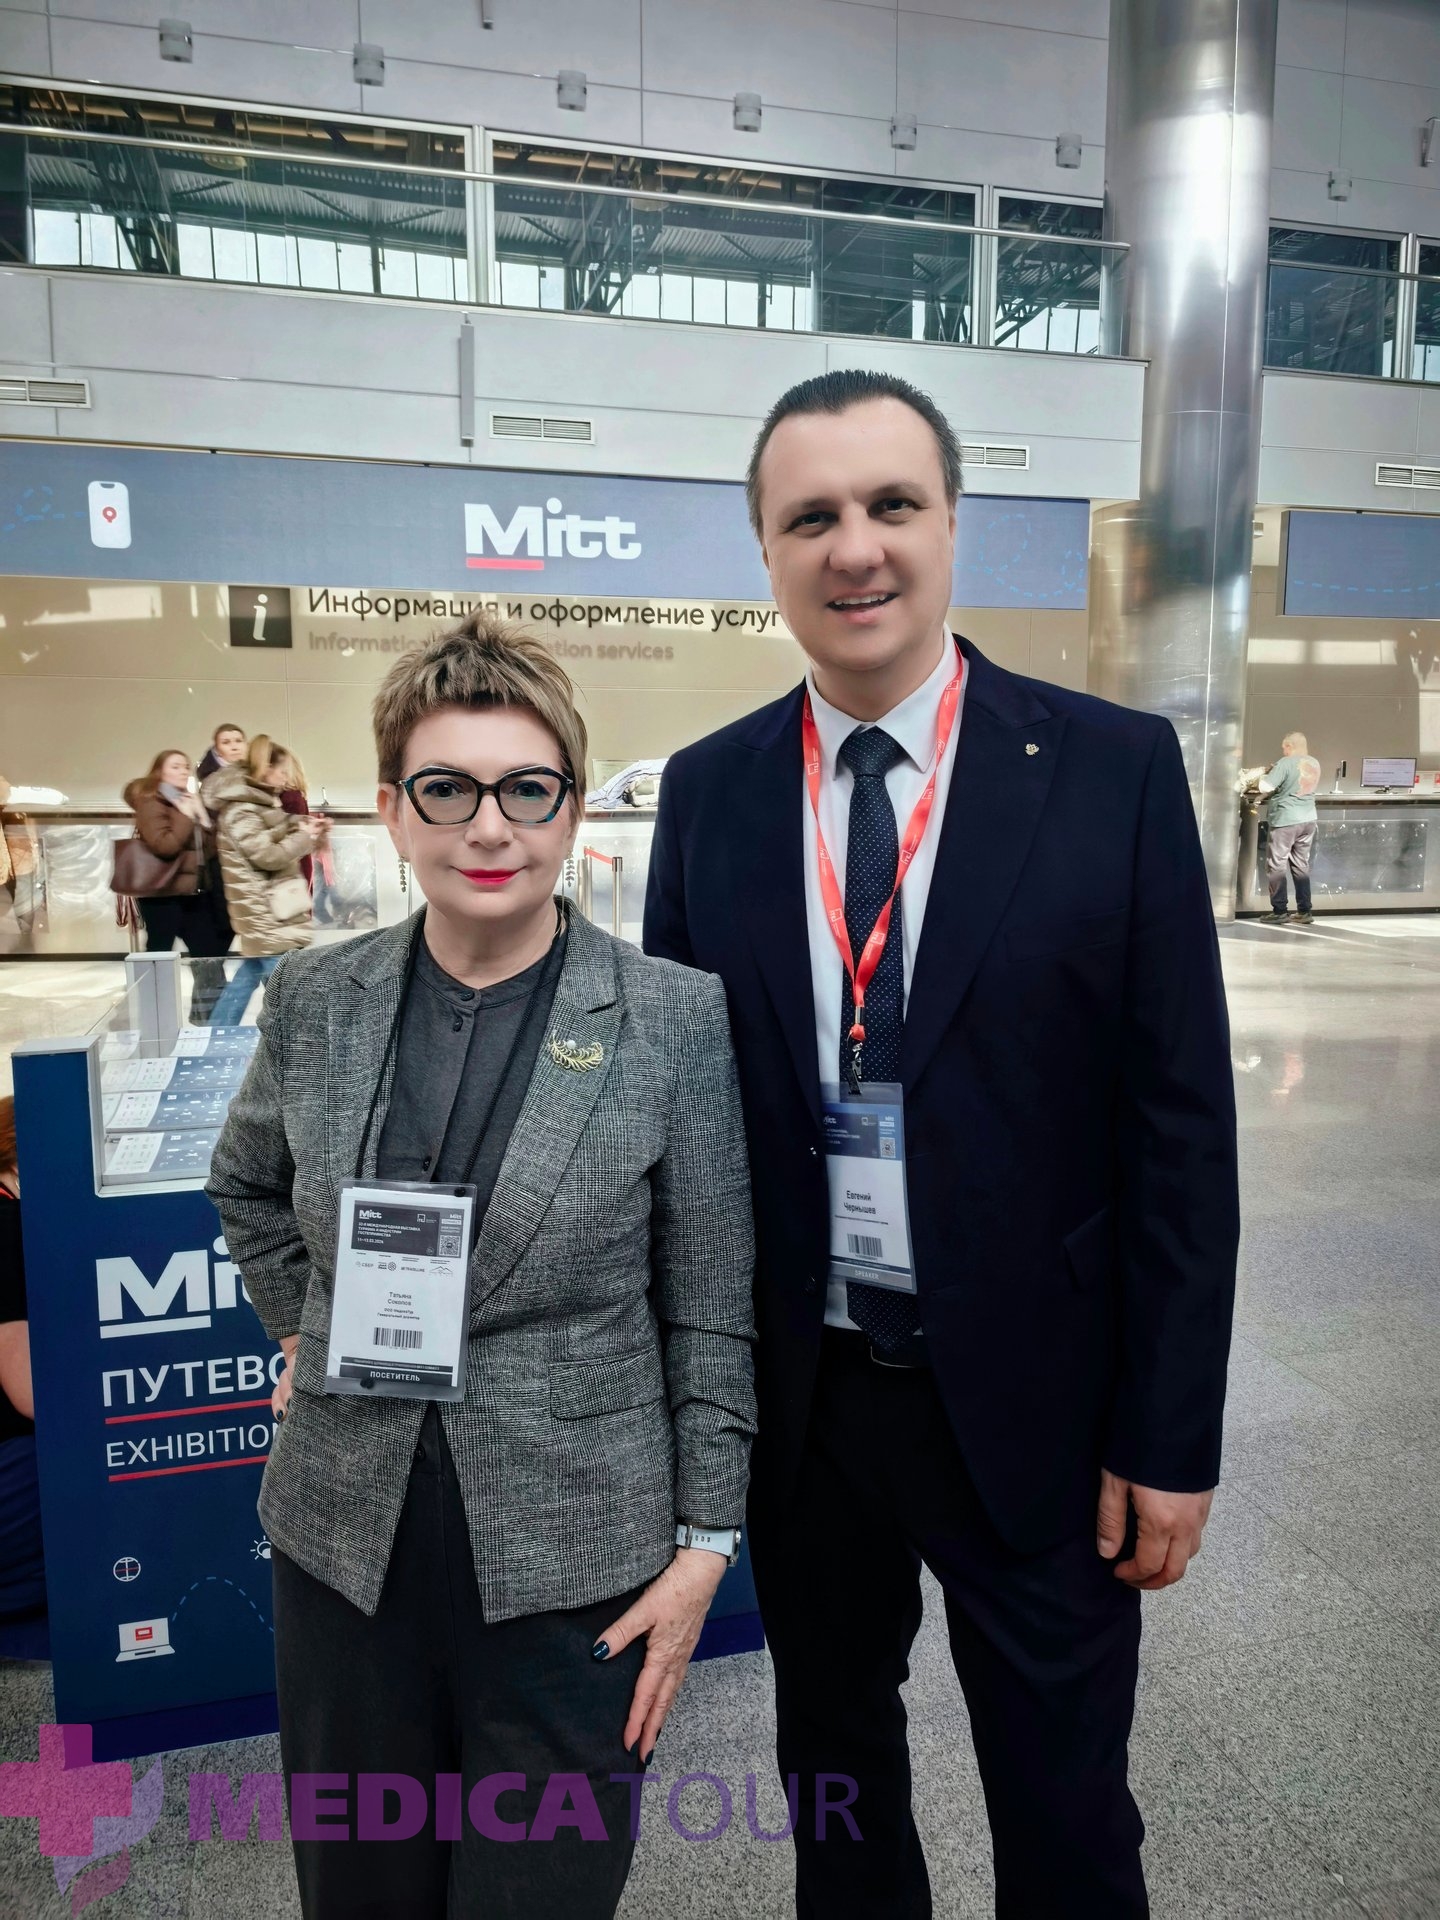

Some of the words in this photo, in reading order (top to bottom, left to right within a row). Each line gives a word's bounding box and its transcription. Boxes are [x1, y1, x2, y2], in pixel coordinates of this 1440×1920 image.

[464, 497, 642, 560] Mitt
[308, 588, 499, 621] Информация
[507, 602, 522, 618] и
[530, 599, 705, 627] оформление
[711, 607, 781, 632] услуг
[846, 1190, 872, 1201] Евгений
[359, 1209, 382, 1219] Mitt
[843, 1202, 876, 1214] Чернышев
[854, 1270, 879, 1280] SPEAKER
[369, 1370, 421, 1382] ПОСЕТИТЕЛЬ
[106, 1422, 279, 1467] EXHIBITIO
